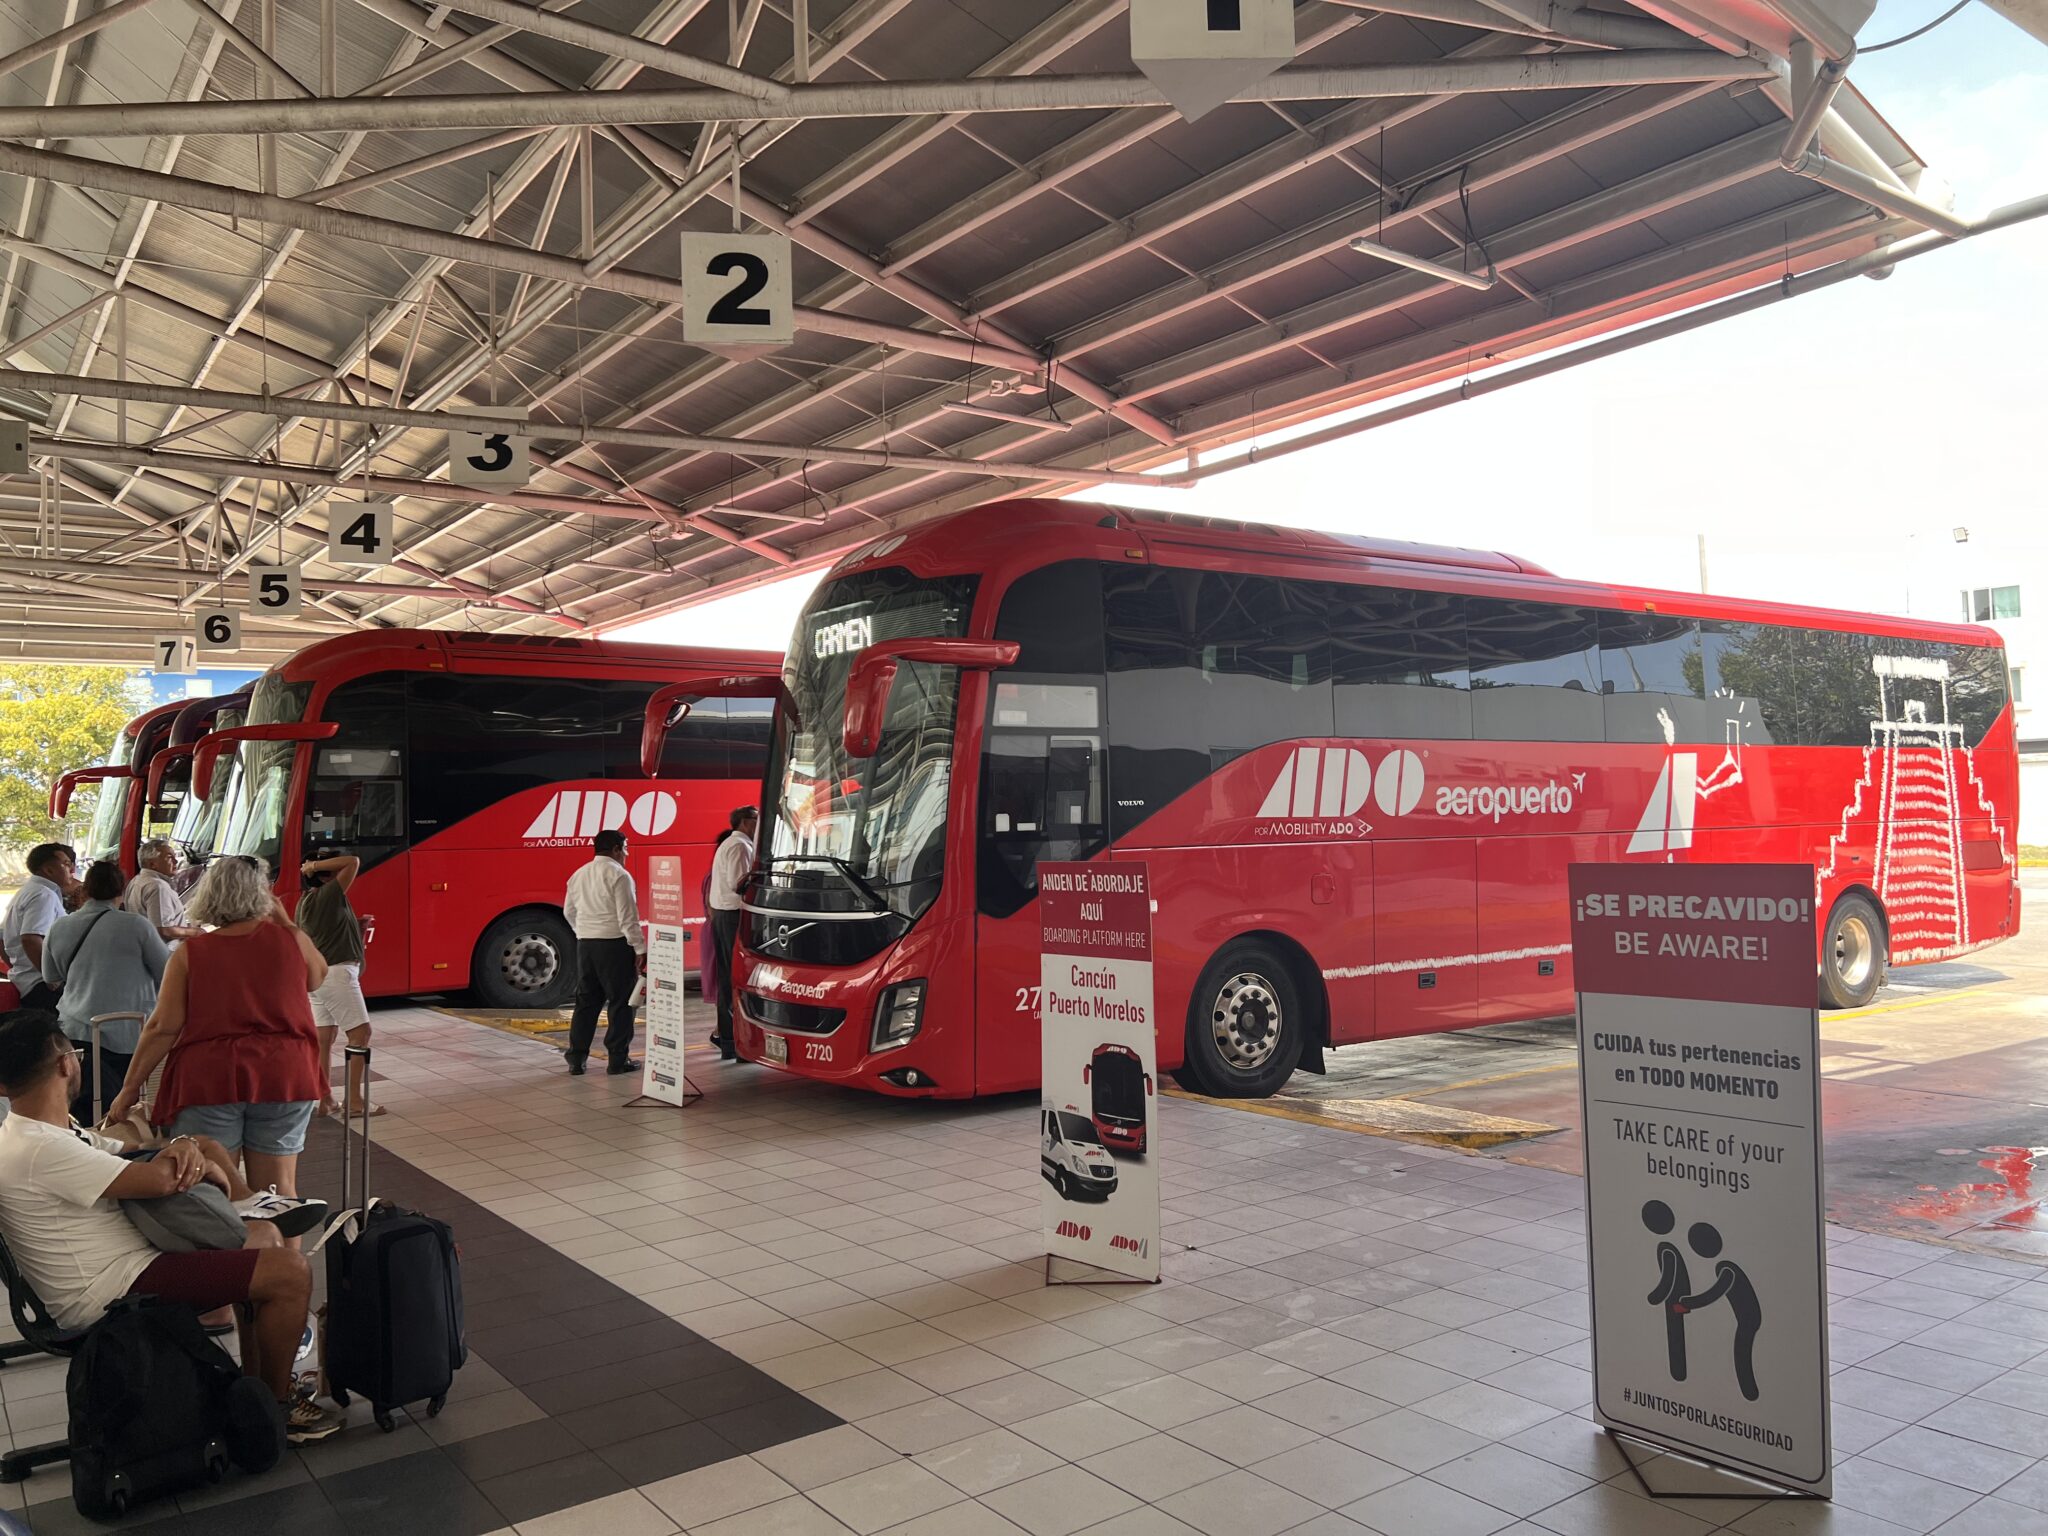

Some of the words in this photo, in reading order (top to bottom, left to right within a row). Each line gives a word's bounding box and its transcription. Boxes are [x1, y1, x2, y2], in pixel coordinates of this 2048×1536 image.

[705, 252, 771, 326] 2
[466, 430, 513, 472] 3
[340, 512, 381, 554] 4
[258, 573, 290, 607] 5
[204, 614, 232, 644] 6
[814, 615, 873, 660] CARMEN
[160, 640, 177, 667] 7
[184, 641, 195, 668] 7
[1255, 747, 1426, 818] ADO
[521, 790, 678, 838] ADO
[1435, 779, 1573, 824] aeropuerto
[536, 838, 586, 848] MOBILITY
[1254, 826, 1268, 836] POR
[1269, 822, 1327, 836] MOBILITY
[1328, 822, 1354, 835] ADO
[1042, 873, 1073, 892] ANDEN
[1075, 874, 1089, 892] DE
[1091, 874, 1145, 894] ABORDAJE
[1080, 898, 1104, 921] AQUÍ
[1576, 893, 1621, 922] ¡SE
[1628, 895, 1810, 923] PRECAVIDO!
[1043, 927, 1081, 944] BOARDING
[1082, 929, 1123, 947] PLATFORM
[1125, 932, 1147, 949] HERE
[1614, 931, 1650, 955] BE
[1657, 934, 1768, 961] AWARE!
[780, 981, 825, 999] aeropuerto
[1071, 964, 1116, 990] Cancún
[1049, 991, 1090, 1017] Puerto
[1093, 995, 1145, 1024] Morelos
[805, 1042, 834, 1062] 2720
[1593, 1032, 1645, 1055] CUIDA
[1648, 1038, 1676, 1058] tus
[1681, 1043, 1801, 1071] pertenencias
[1615, 1067, 1635, 1084] en
[1639, 1066, 1685, 1089] TODO
[1689, 1073, 1779, 1100] MOMENTO
[1112, 1126, 1128, 1136] ADO
[1613, 1118, 1657, 1145] TAKE
[1663, 1125, 1710, 1153] CARE
[1716, 1134, 1735, 1157] of
[1741, 1141, 1785, 1164] your
[1646, 1152, 1751, 1193] belongings
[1055, 1220, 1091, 1241] ADO
[1109, 1234, 1139, 1253] ADO
[1623, 1387, 1794, 1452] #JUNTOSPORLASEGURIDAD
